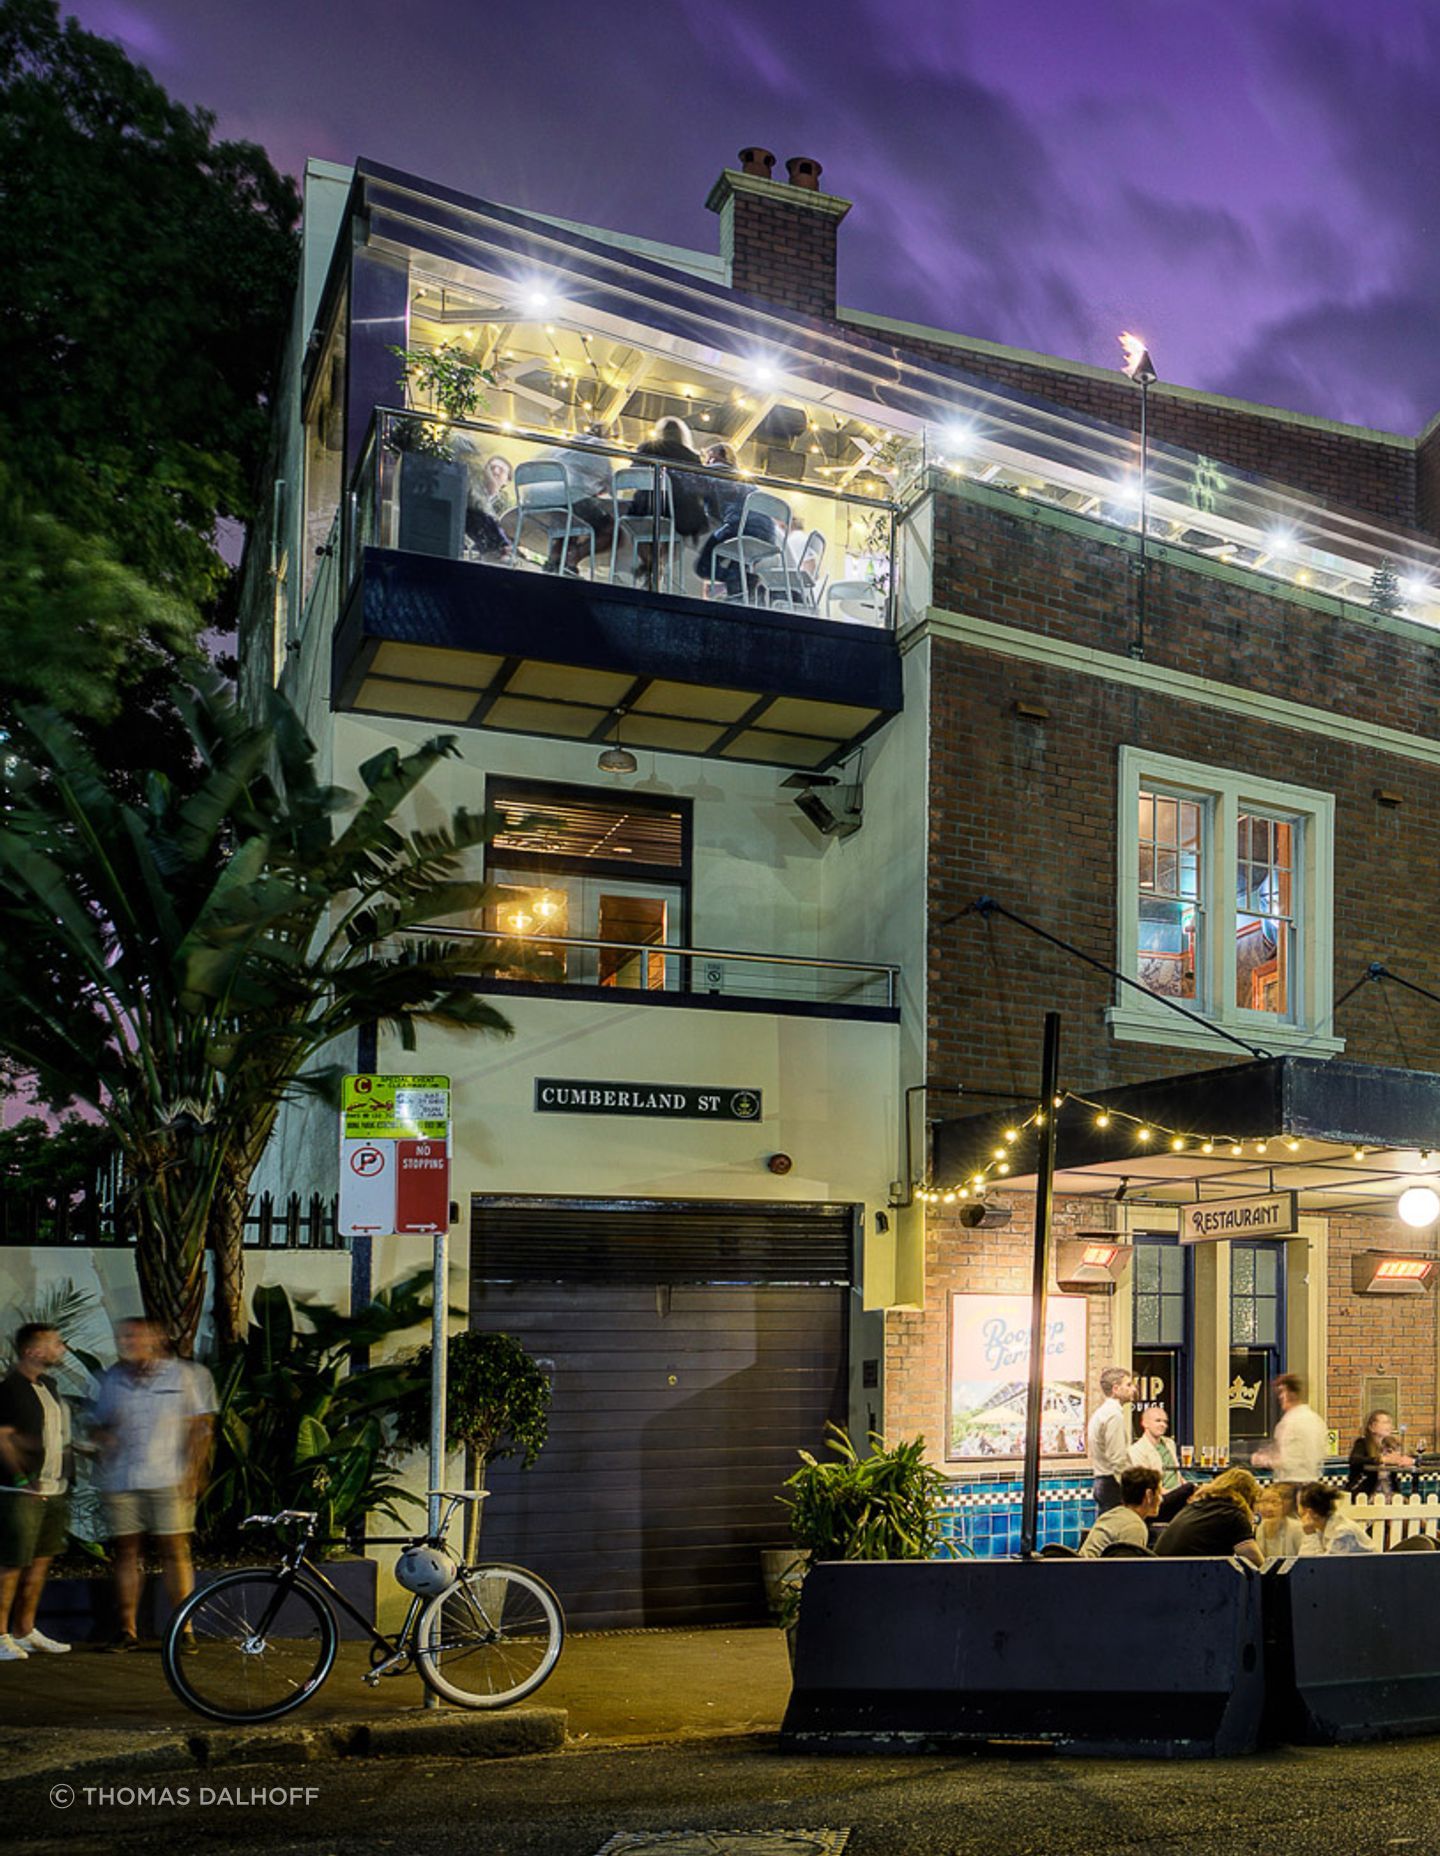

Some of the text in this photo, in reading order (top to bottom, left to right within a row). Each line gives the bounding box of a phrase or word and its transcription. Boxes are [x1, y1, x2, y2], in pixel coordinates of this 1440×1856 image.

[542, 1087, 722, 1111] CUMBERLAND ST
[416, 1145, 431, 1156] NO
[402, 1158, 445, 1170] STOPPING
[1191, 1204, 1280, 1235] RESTAURANT
